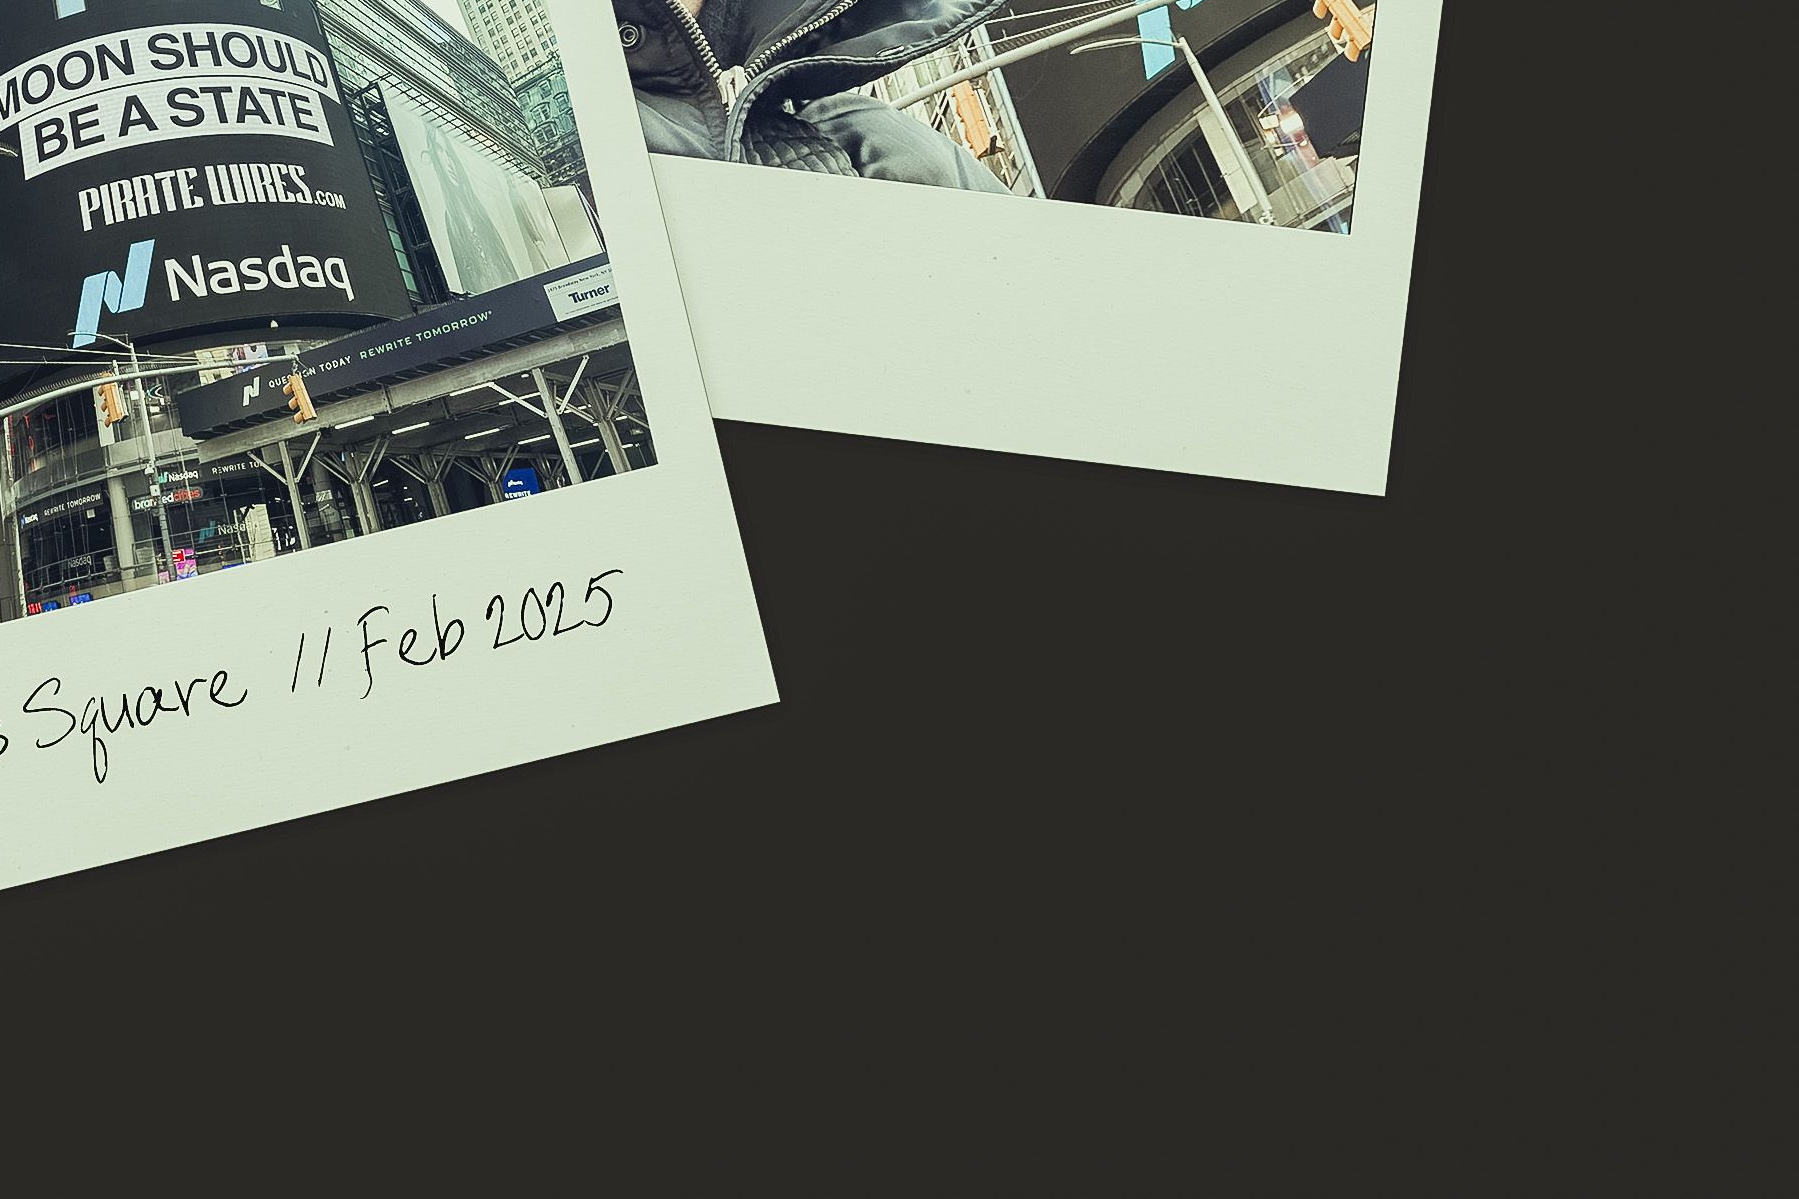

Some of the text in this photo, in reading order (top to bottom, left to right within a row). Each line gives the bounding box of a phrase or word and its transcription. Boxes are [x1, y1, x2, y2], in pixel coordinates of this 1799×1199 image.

[147, 31, 329, 89] SHOULD
[33, 86, 321, 163] BE A STATE
[77, 168, 204, 232] PIRATE
[164, 244, 355, 302] Nasdaq
[568, 284, 610, 303] Turner
[268, 365, 317, 389] QUESION
[318, 355, 352, 373] TODAY
[359, 336, 413, 361] REWRITE
[211, 461, 247, 475] REWRITE
[22, 668, 248, 785] Square
[357, 594, 466, 701] Feb
[483, 567, 624, 651] 2025
